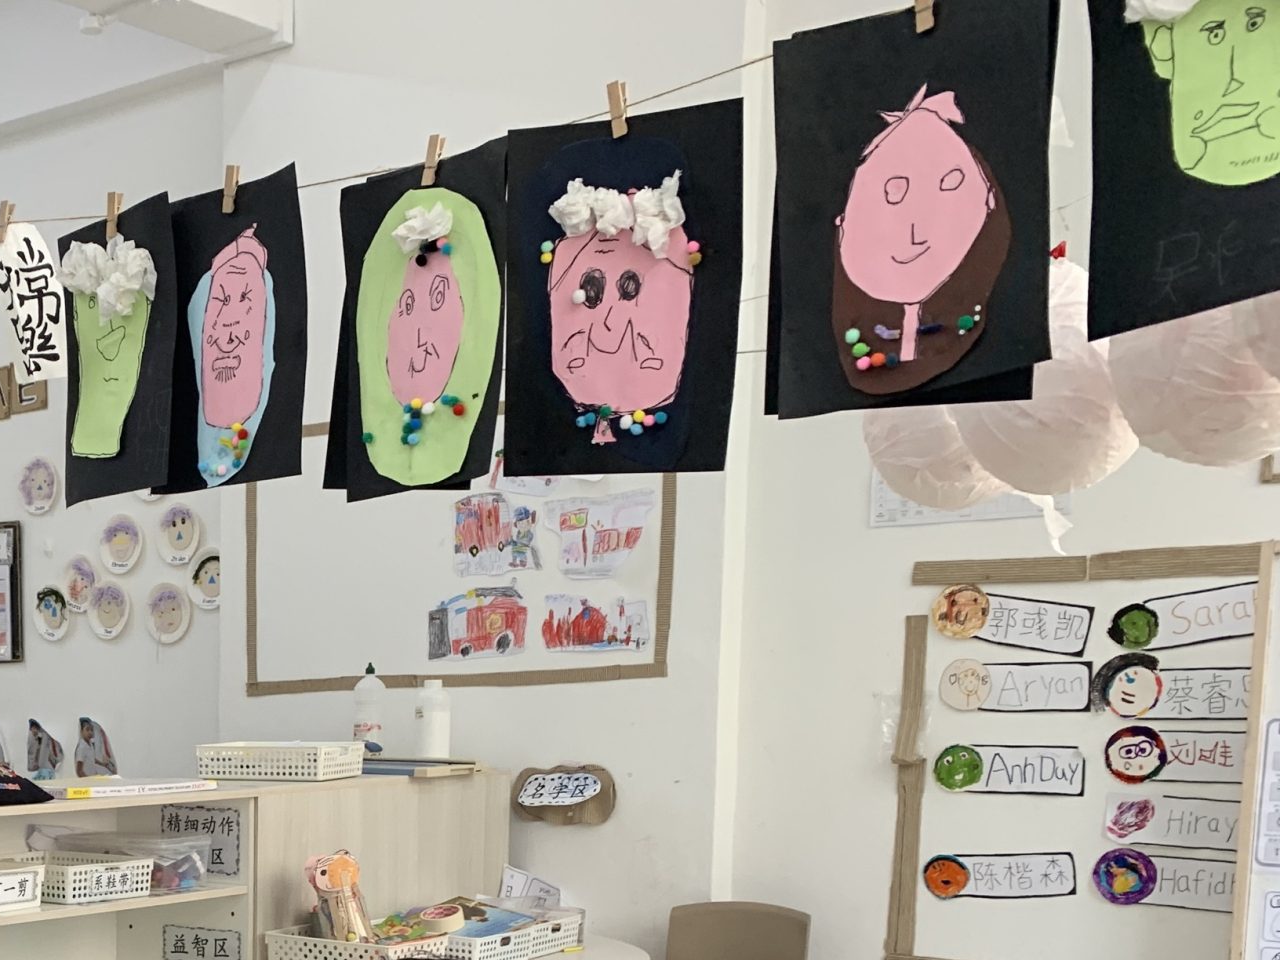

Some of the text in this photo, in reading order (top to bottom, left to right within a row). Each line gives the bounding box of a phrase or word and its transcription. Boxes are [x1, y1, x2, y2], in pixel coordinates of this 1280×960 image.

[996, 670, 1084, 707] Aryan
[165, 815, 237, 836] 精细动作
[211, 848, 225, 865] 区
[93, 872, 130, 891] 系鞋带
[972, 856, 1070, 892] 陈楷森
[170, 933, 231, 958] 益智区
